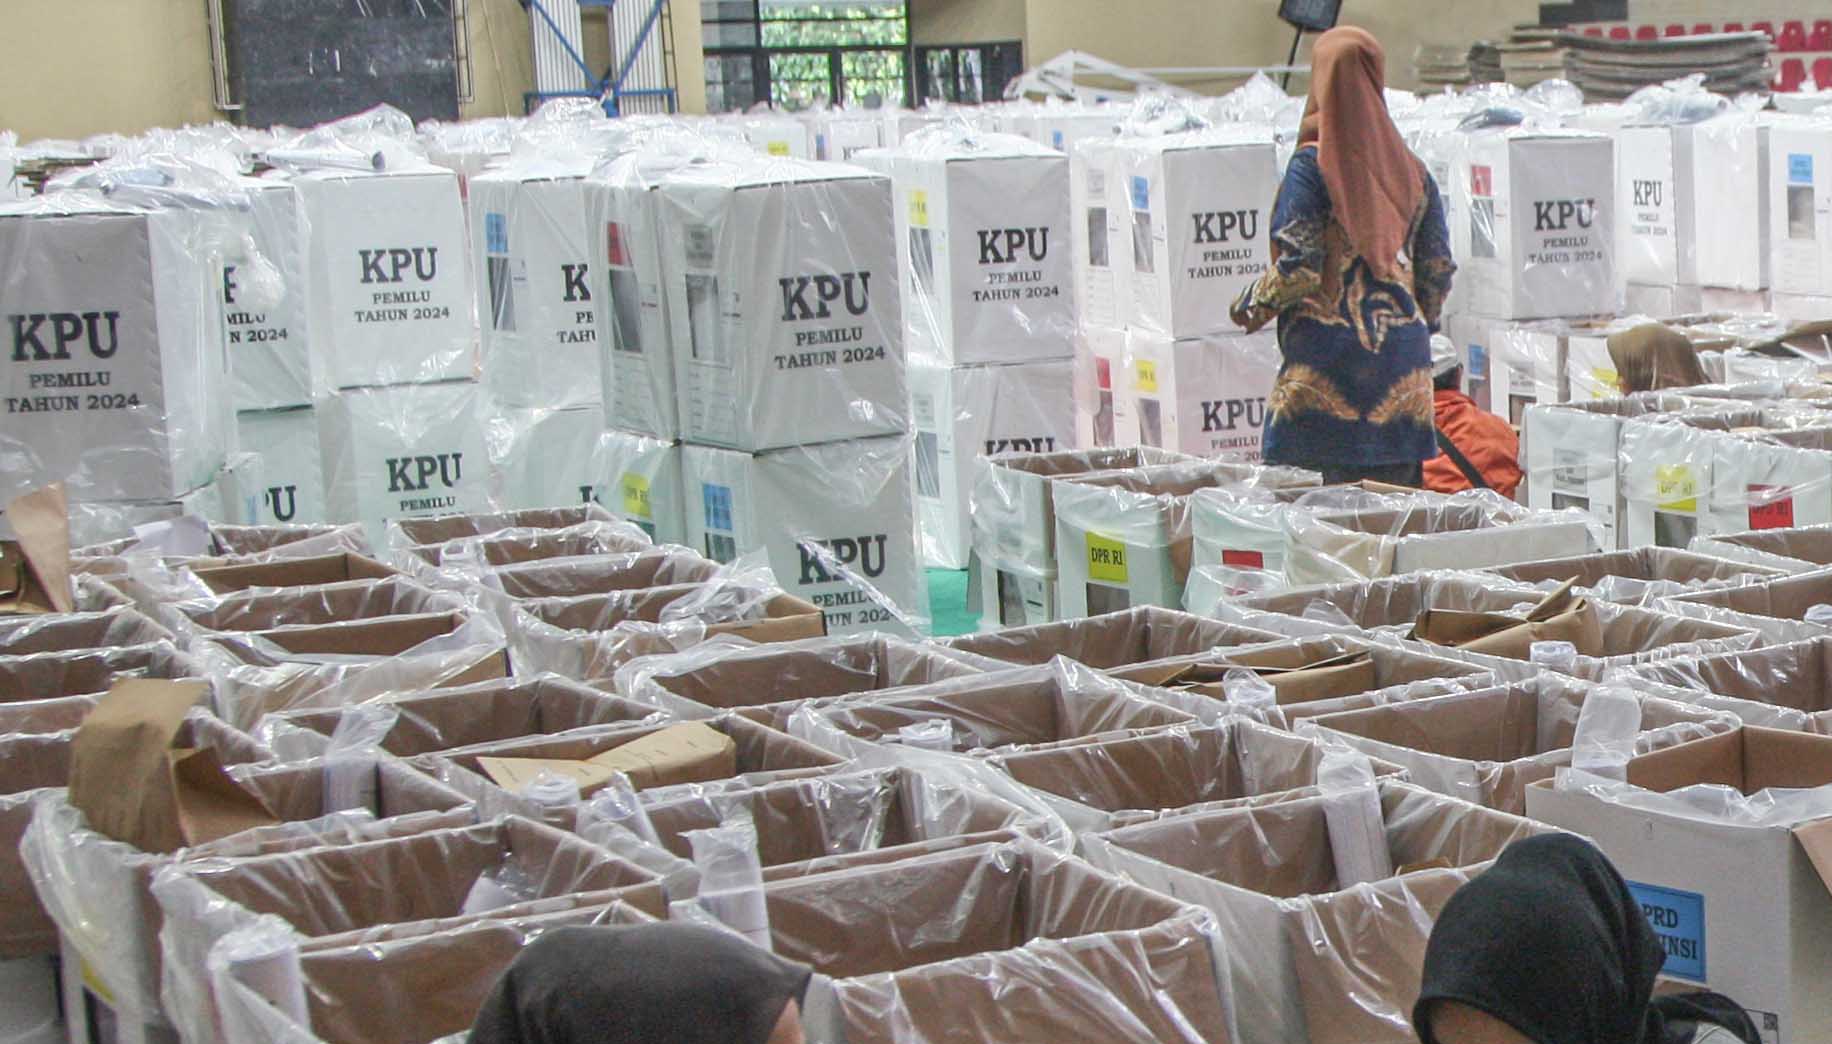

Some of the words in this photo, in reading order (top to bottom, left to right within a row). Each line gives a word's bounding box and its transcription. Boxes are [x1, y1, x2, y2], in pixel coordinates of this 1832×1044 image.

[1632, 179, 1663, 208] KPU
[1533, 199, 1596, 232] KPU
[1192, 208, 1260, 245] KPU
[977, 226, 1049, 265] KPU
[1542, 236, 1589, 249] PEMILU
[1202, 247, 1253, 263] PEMILU
[358, 246, 438, 285] KPU
[1187, 266, 1234, 280] TAHUN
[1236, 261, 1269, 277] 2024
[987, 269, 1042, 284] PEMILU
[372, 290, 431, 306] PEMILU
[779, 270, 871, 322] KPU
[972, 288, 1022, 302] TAHUN
[1025, 285, 1060, 299] 2024
[227, 312, 266, 327] MILU
[355, 308, 408, 324] TAHUN
[413, 305, 450, 321] 2024
[9, 311, 120, 362] KPU
[247, 328, 289, 343] 2024
[556, 330, 597, 344] TAH
[795, 326, 864, 346] PEMILU
[774, 350, 838, 371] TAHUN
[843, 346, 887, 365] 2024
[29, 371, 111, 389] PEMILU
[7, 396, 80, 414] TAHUN
[87, 393, 140, 411] 2024
[1200, 397, 1267, 433] KPU
[1211, 436, 1260, 450] PEMILU
[386, 452, 464, 494] KPU
[400, 495, 457, 512] PEMILU
[796, 534, 888, 586] KPU
[1091, 546, 1111, 564] DPR
[812, 590, 873, 609] PEMIL
[859, 608, 896, 625] 202
[1642, 902, 1678, 929] PRD
[1659, 934, 1699, 961] INSI
